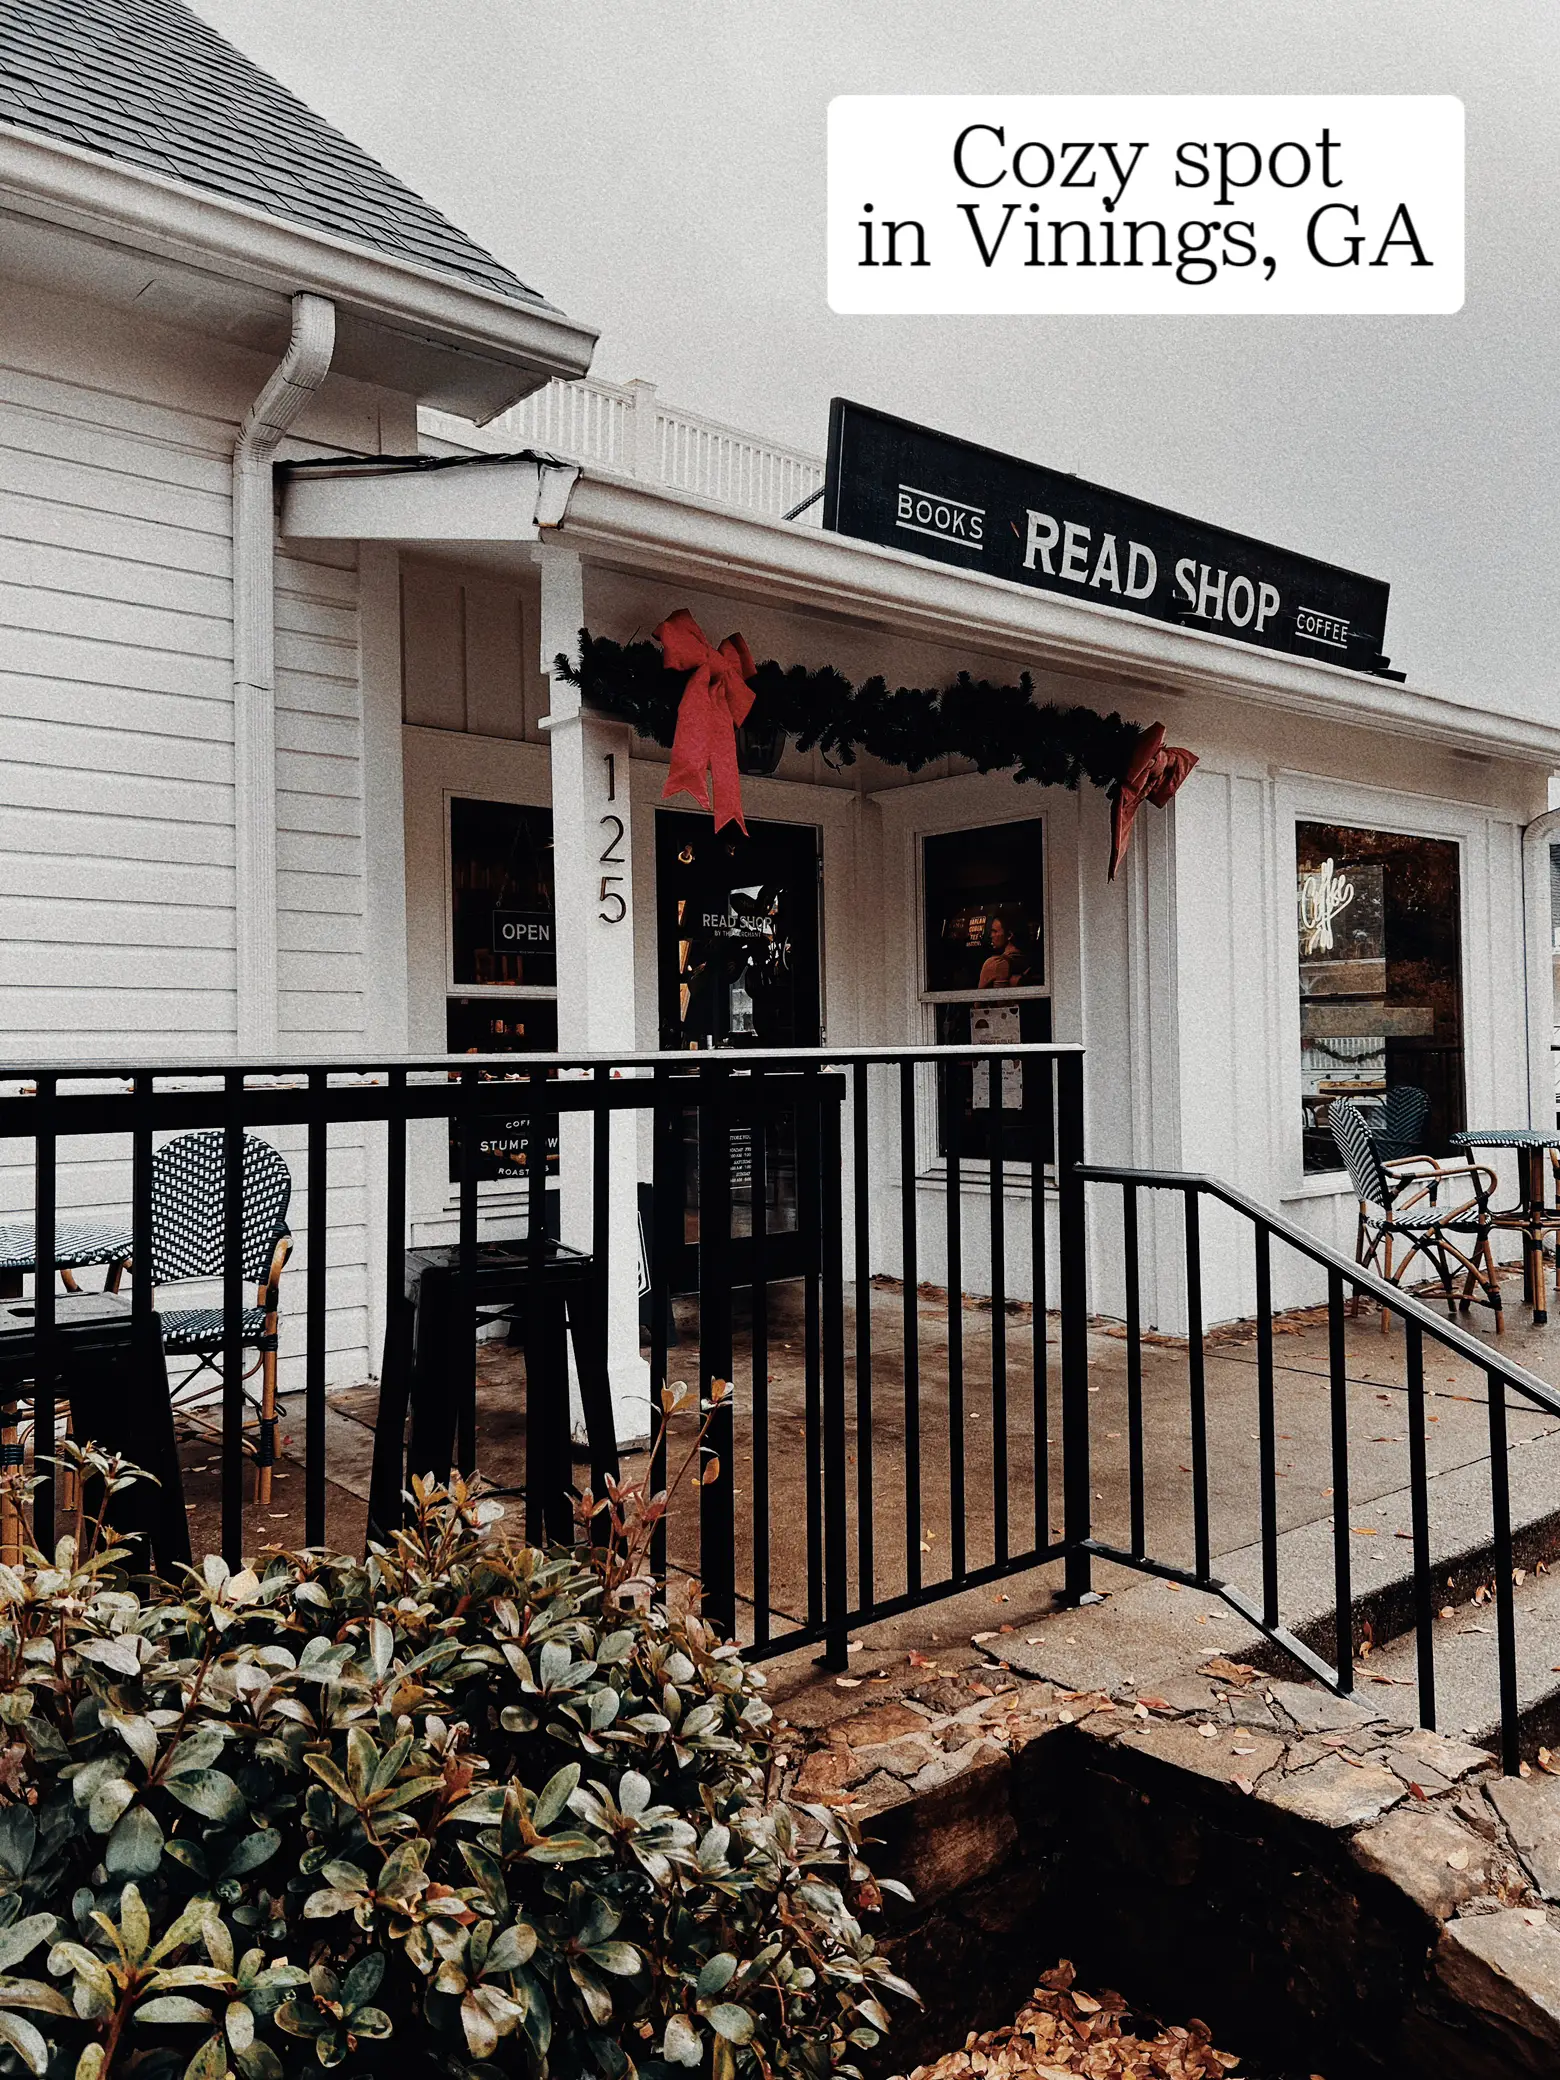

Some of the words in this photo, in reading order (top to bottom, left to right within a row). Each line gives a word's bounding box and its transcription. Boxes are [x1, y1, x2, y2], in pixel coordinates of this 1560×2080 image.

[897, 492, 984, 541] BOOKS
[1022, 508, 1158, 600] READ
[1172, 557, 1281, 633] SHOP
[1296, 613, 1349, 643] COFFEE
[702, 913, 736, 928] READ
[739, 915, 773, 930] SHOP
[502, 923, 550, 941] OPEN
[479, 1137, 559, 1152] STUMPW
[497, 1165, 550, 1176] ROASTS
